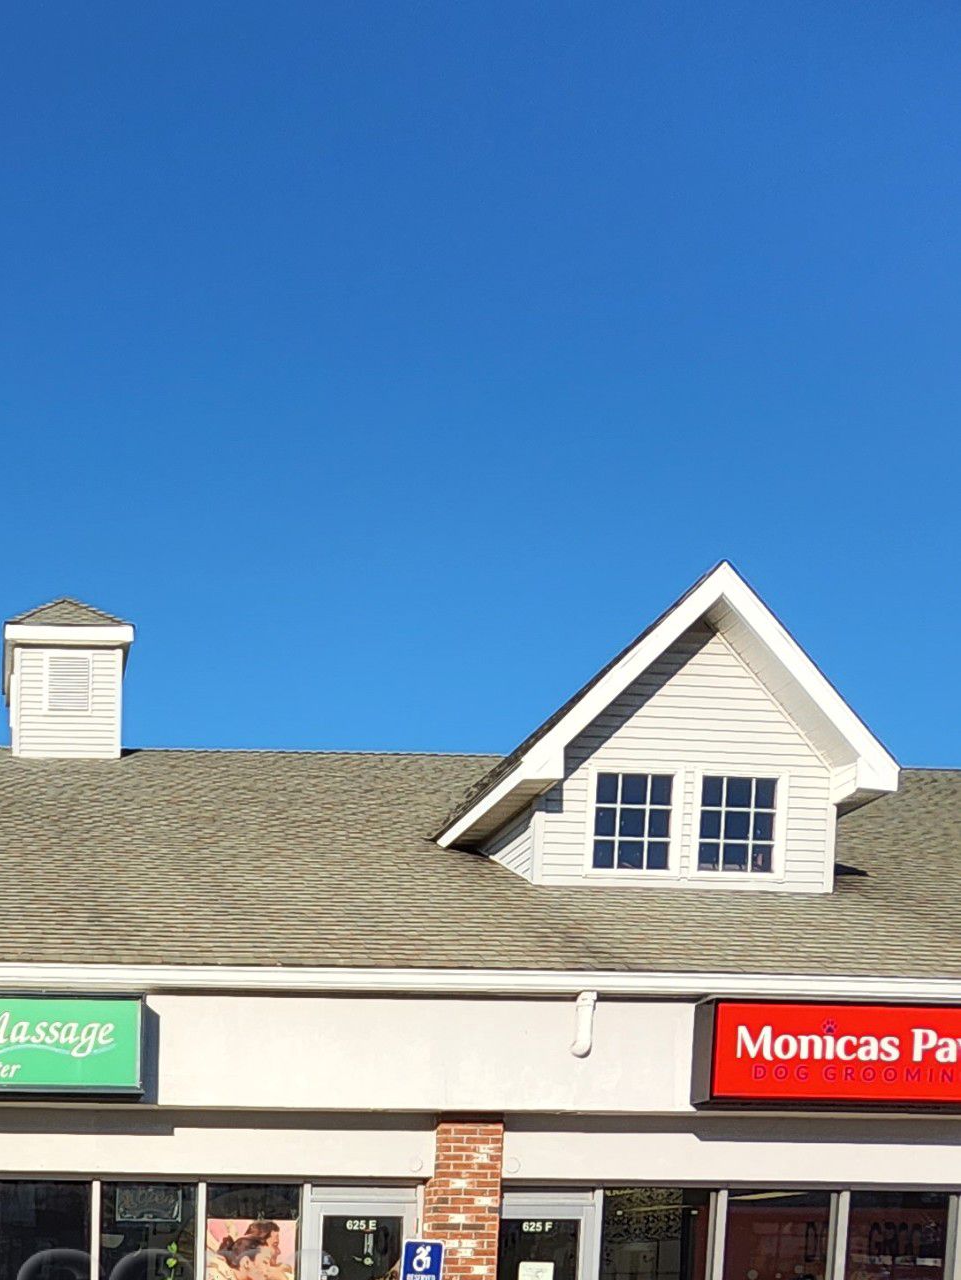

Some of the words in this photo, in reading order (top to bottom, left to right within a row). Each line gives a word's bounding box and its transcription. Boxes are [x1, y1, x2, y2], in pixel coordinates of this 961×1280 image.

[735, 1024, 900, 1063] Monicas
[910, 1028, 960, 1063] Pa
[753, 1065, 809, 1081] DOG
[346, 1219, 366, 1230] 625
[368, 1220, 377, 1230] E
[522, 1221, 543, 1232] 625
[545, 1222, 553, 1232] F
